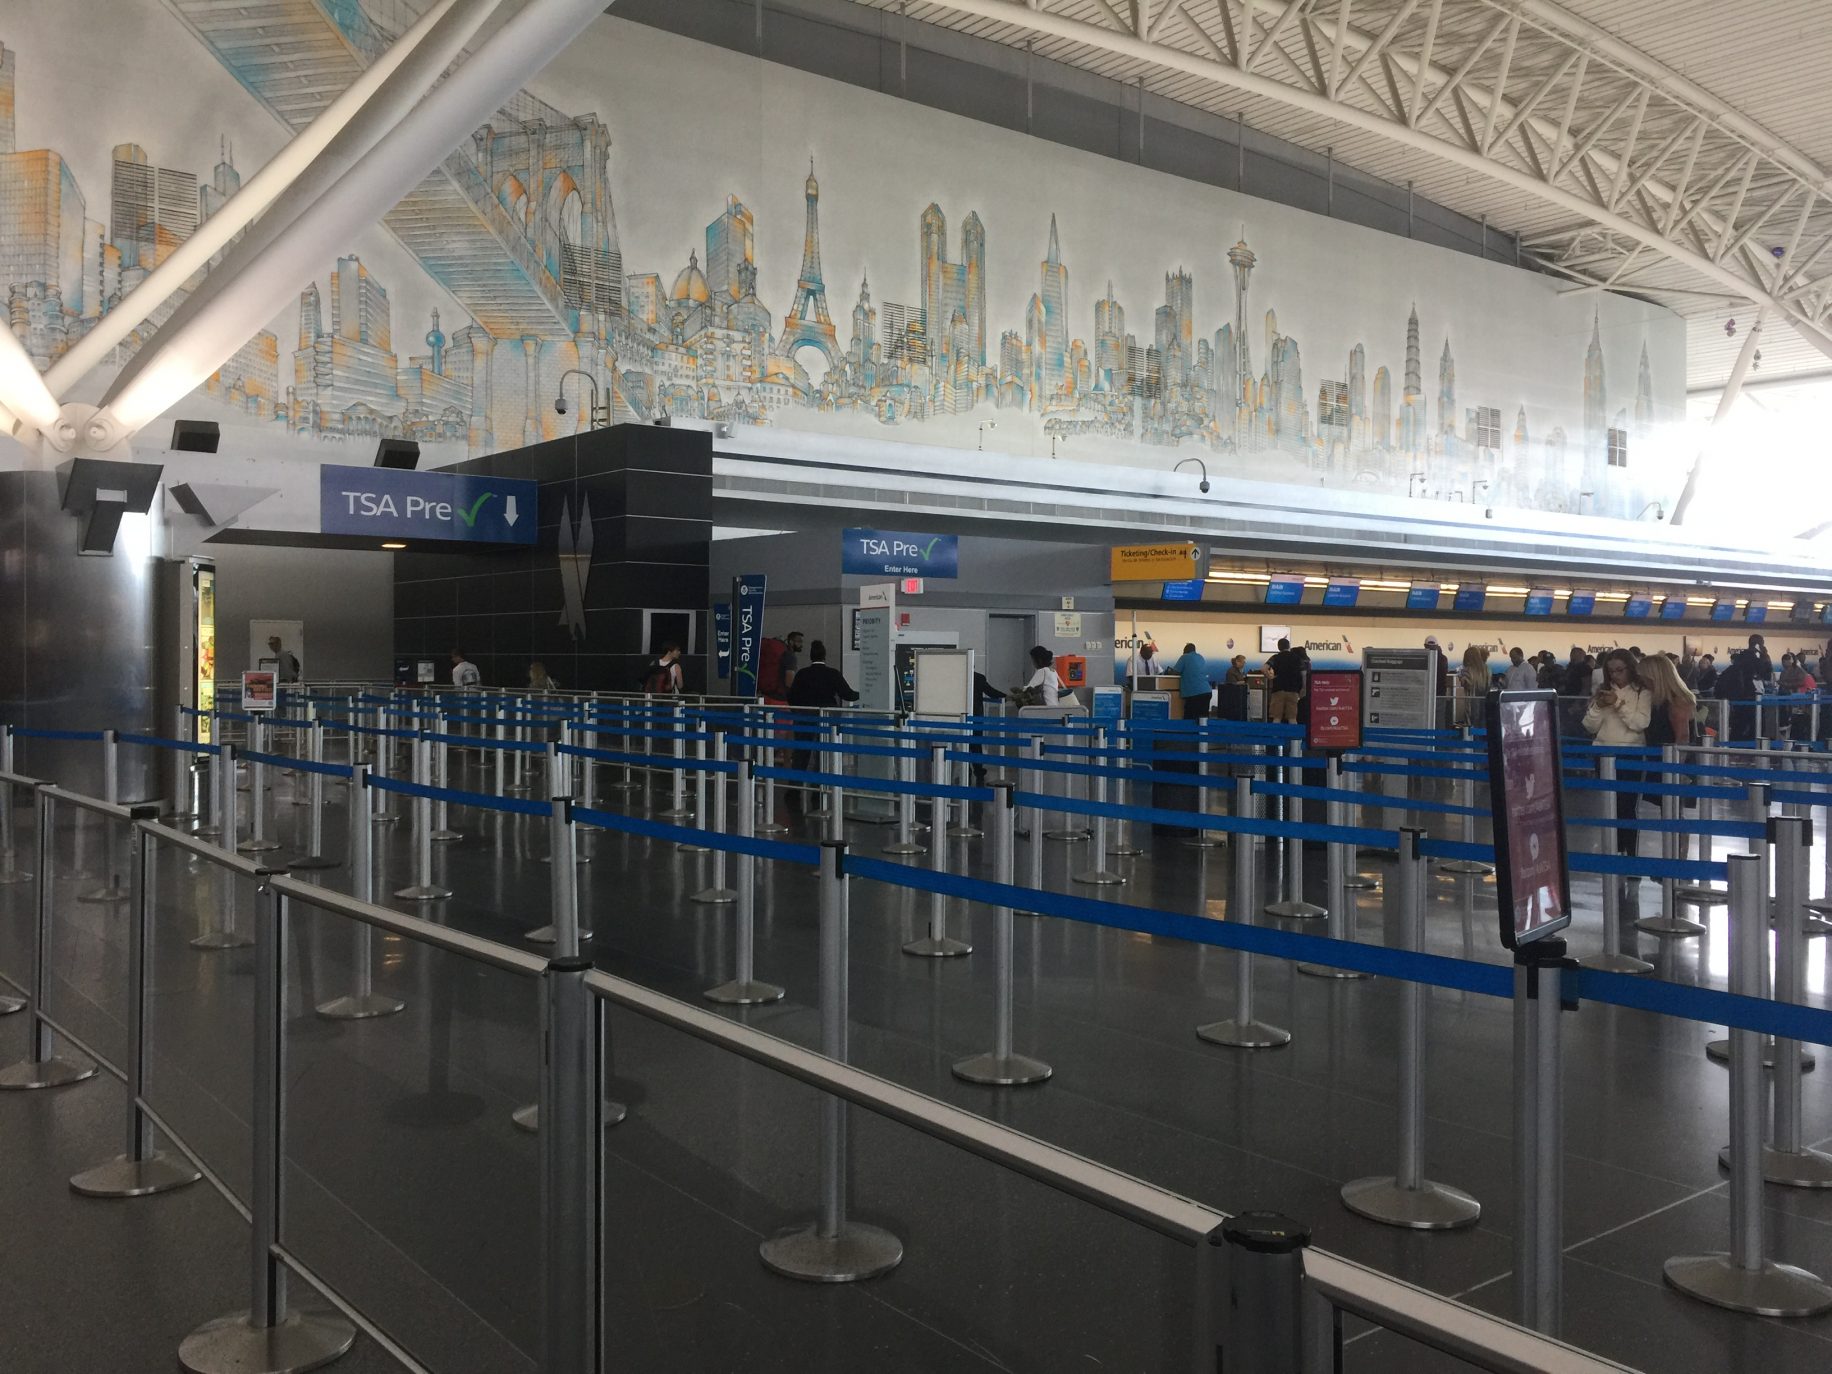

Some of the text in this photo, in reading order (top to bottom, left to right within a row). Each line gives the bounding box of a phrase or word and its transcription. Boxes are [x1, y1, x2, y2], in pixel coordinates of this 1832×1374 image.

[342, 491, 452, 521] TSA Pre
[860, 538, 918, 557] TSA Pre
[884, 564, 919, 574] Enter Here
[741, 604, 753, 662] TSA Pre
[1114, 636, 1144, 649] ericn
[1304, 639, 1342, 651] American
